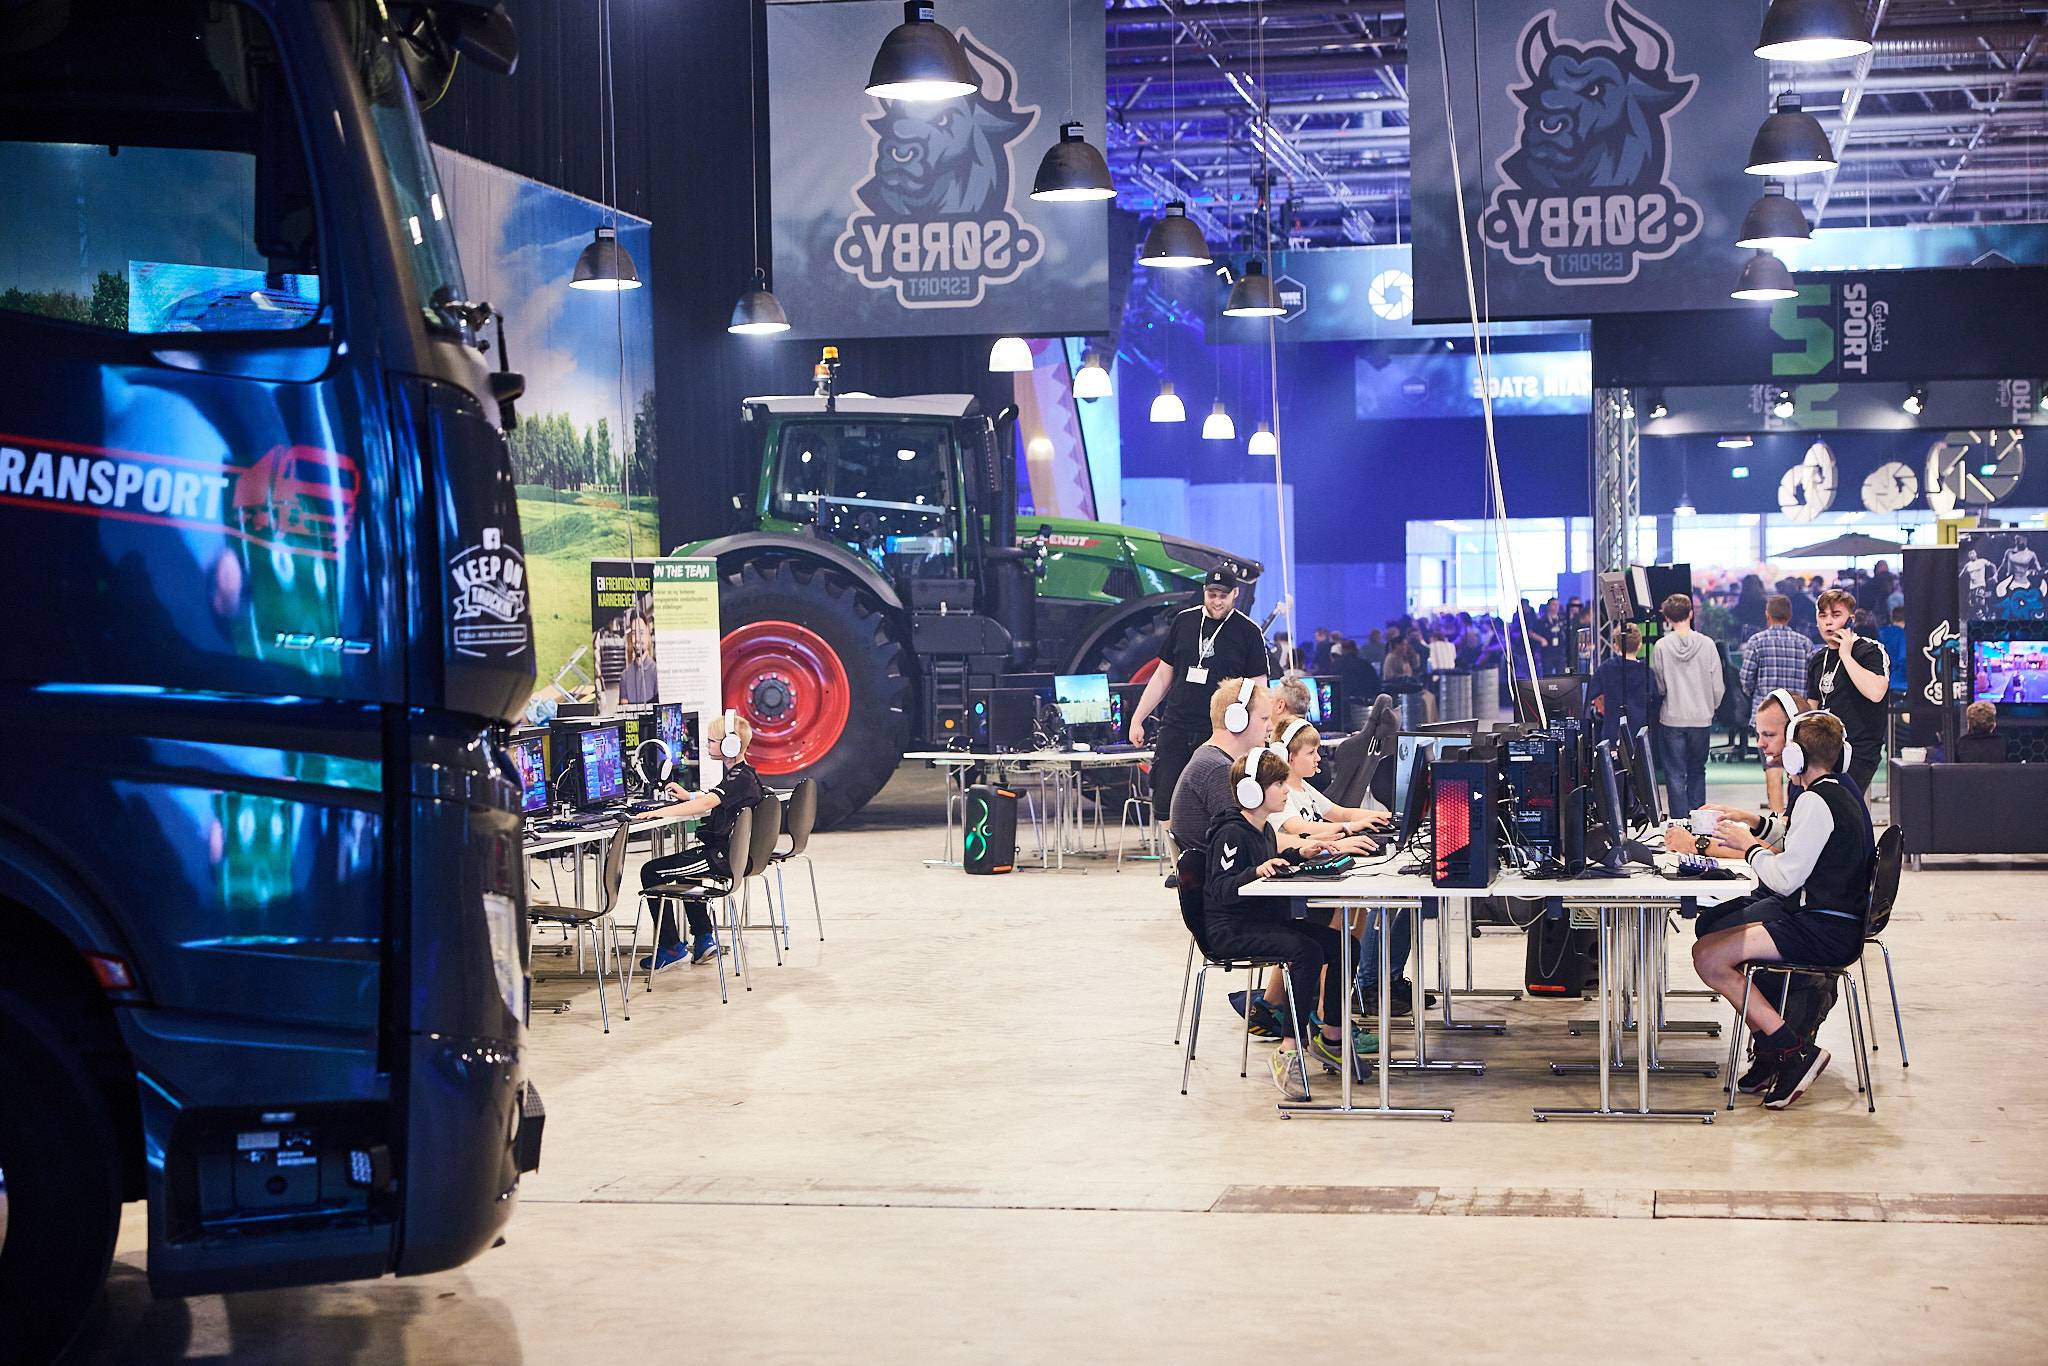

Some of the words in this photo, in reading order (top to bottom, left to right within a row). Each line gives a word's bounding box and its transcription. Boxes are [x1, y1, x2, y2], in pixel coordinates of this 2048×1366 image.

[1843, 283, 1867, 374] SPORT
[1868, 300, 1889, 352] Carlsberg
[1039, 534, 1089, 547] ENDT
[452, 555, 501, 592] KEEP
[653, 564, 665, 578] IN
[666, 564, 684, 579] THE
[685, 564, 710, 579] TEAM
